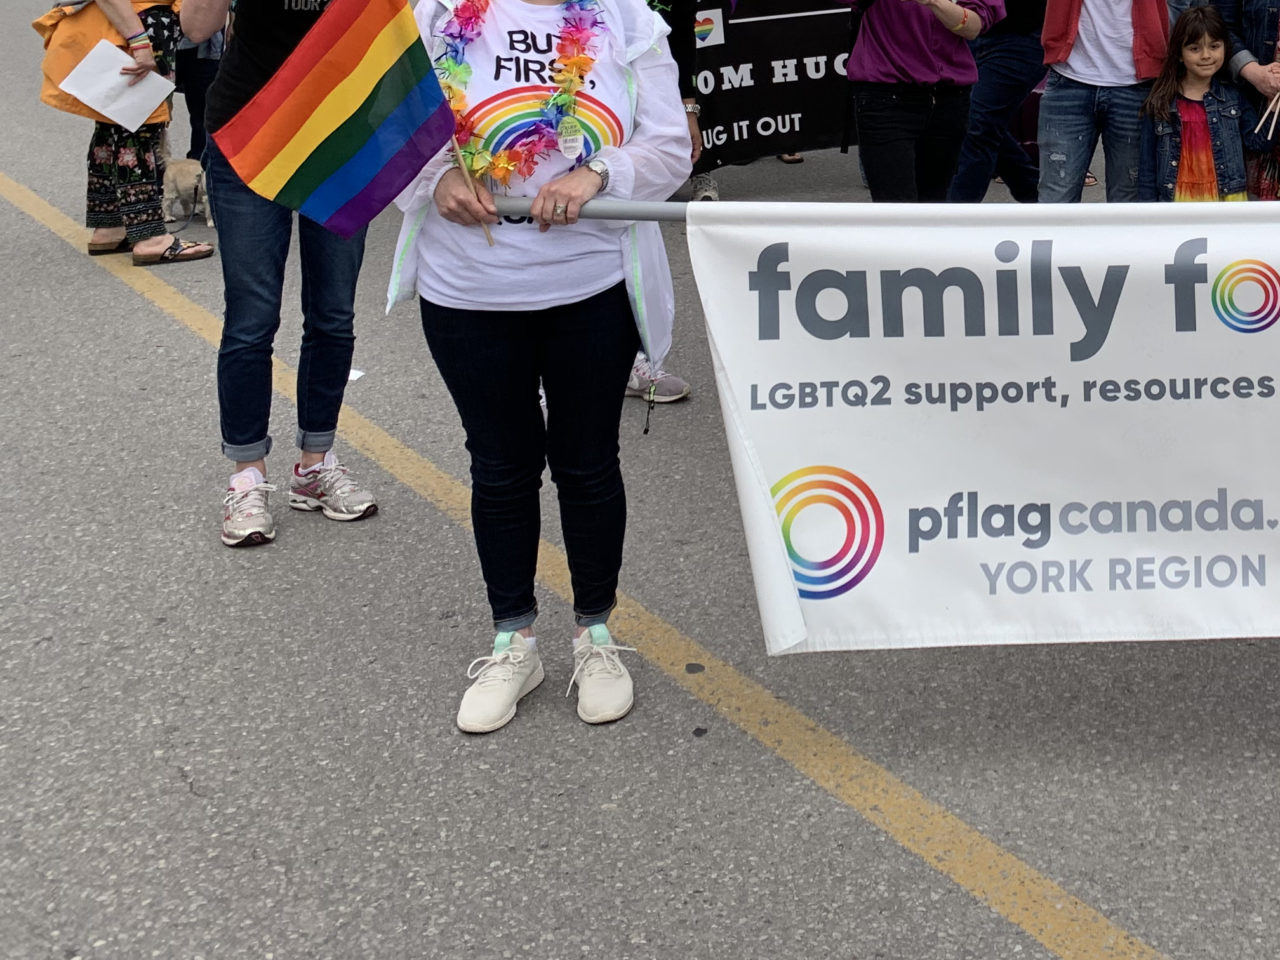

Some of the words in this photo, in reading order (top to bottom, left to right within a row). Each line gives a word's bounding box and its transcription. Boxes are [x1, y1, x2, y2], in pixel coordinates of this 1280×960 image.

[697, 63, 754, 95] OM
[701, 126, 727, 150] UG
[733, 120, 750, 141] IT
[756, 113, 802, 136] OUT
[748, 239, 1130, 362] family
[751, 376, 892, 410] LGBTQ2
[905, 376, 1070, 411] support,
[1084, 376, 1275, 402] resources
[980, 559, 1094, 596] YORK
[1109, 554, 1266, 591] REGION
